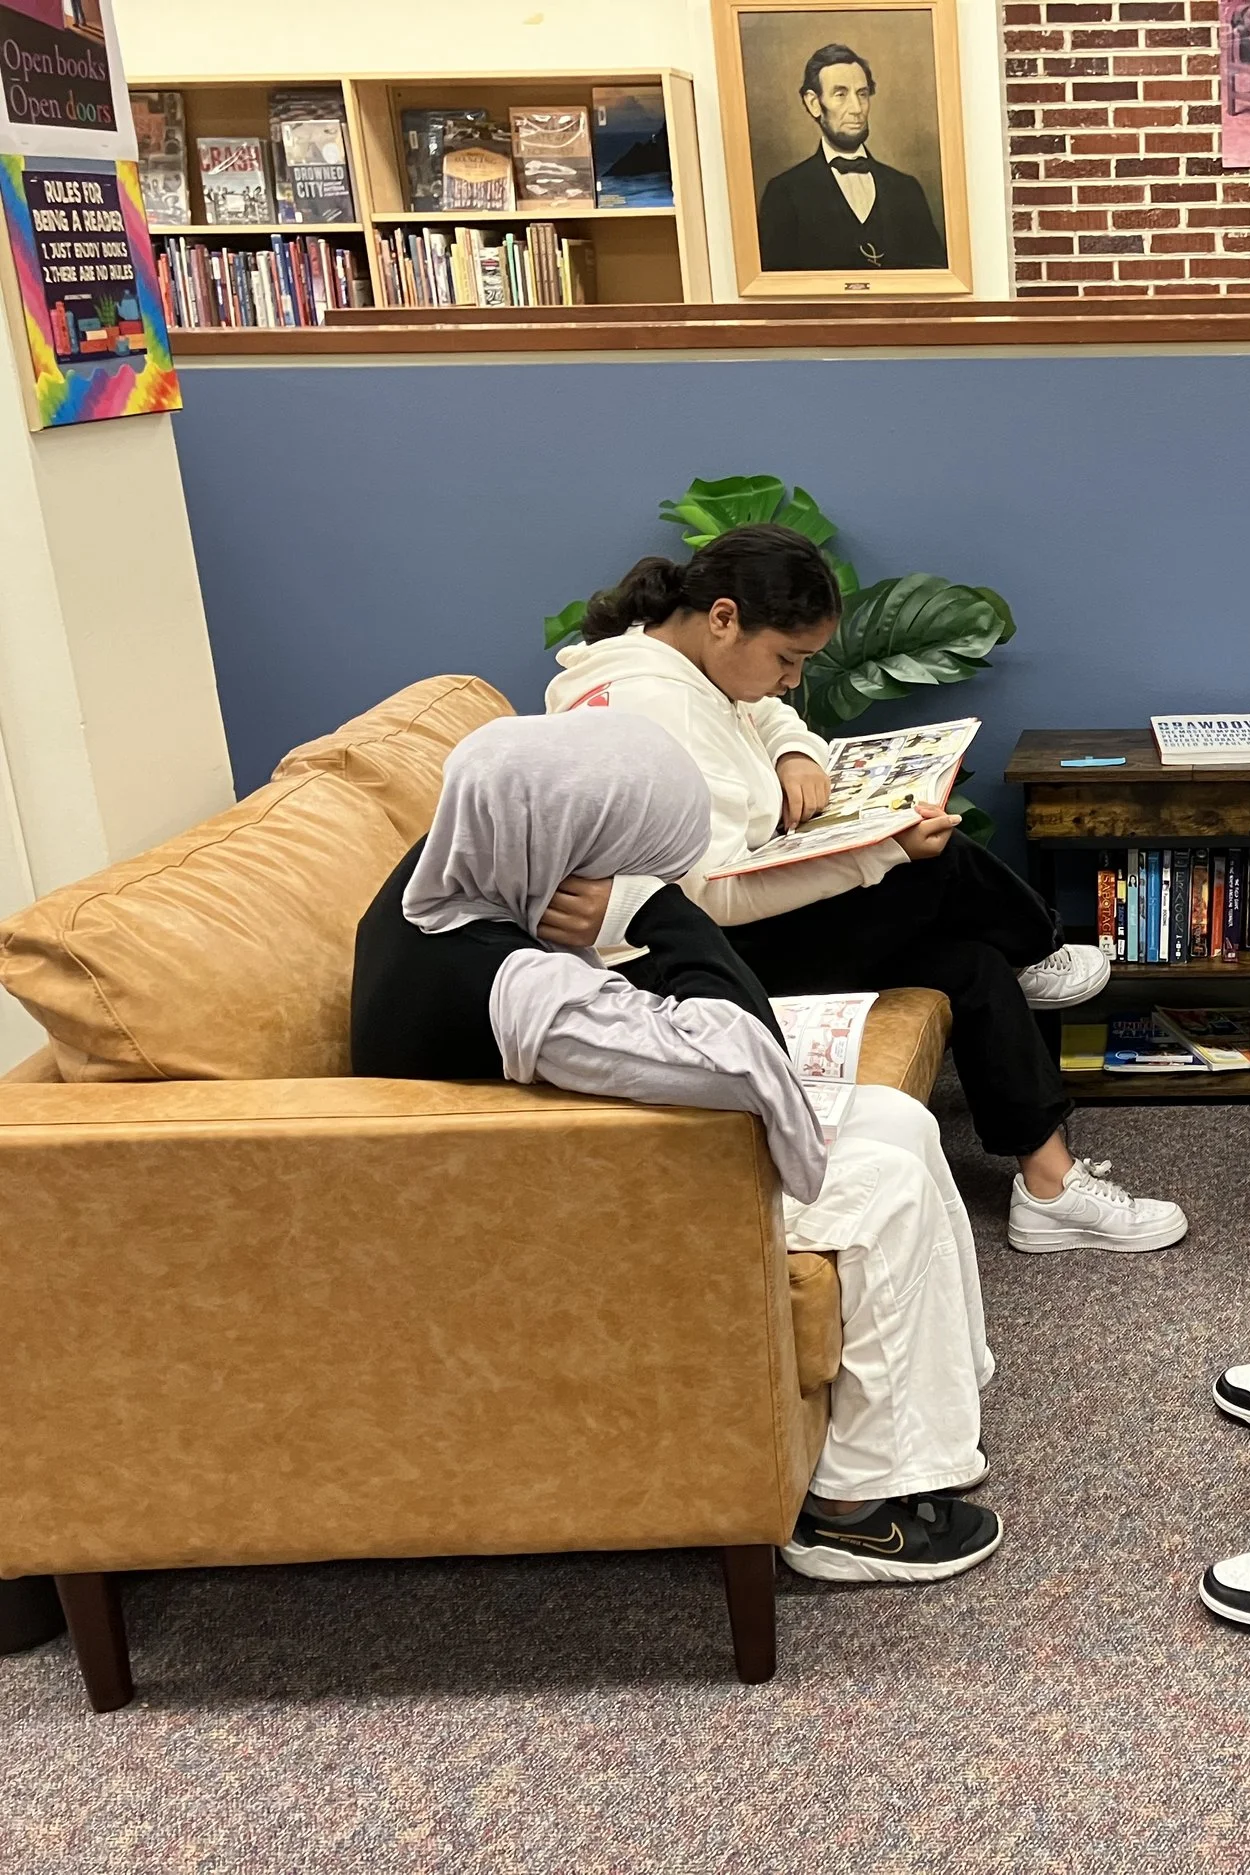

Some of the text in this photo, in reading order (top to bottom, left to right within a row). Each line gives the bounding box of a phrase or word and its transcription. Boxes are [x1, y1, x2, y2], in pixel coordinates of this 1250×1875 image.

[3, 39, 106, 82] Open books
[10, 84, 112, 124] Open doors
[293, 165, 345, 181] DROWNED
[43, 180, 105, 204] RULES FOR
[296, 181, 324, 198] CITY
[32, 208, 125, 233] BEING A READER
[49, 242, 72, 259] JUST
[73, 242, 100, 258] ENJOY
[101, 241, 128, 258] BOOKS
[49, 265, 78, 283] THERE
[79, 264, 96, 282] ARE
[95, 264, 109, 281] NO
[108, 263, 134, 281] RULES
